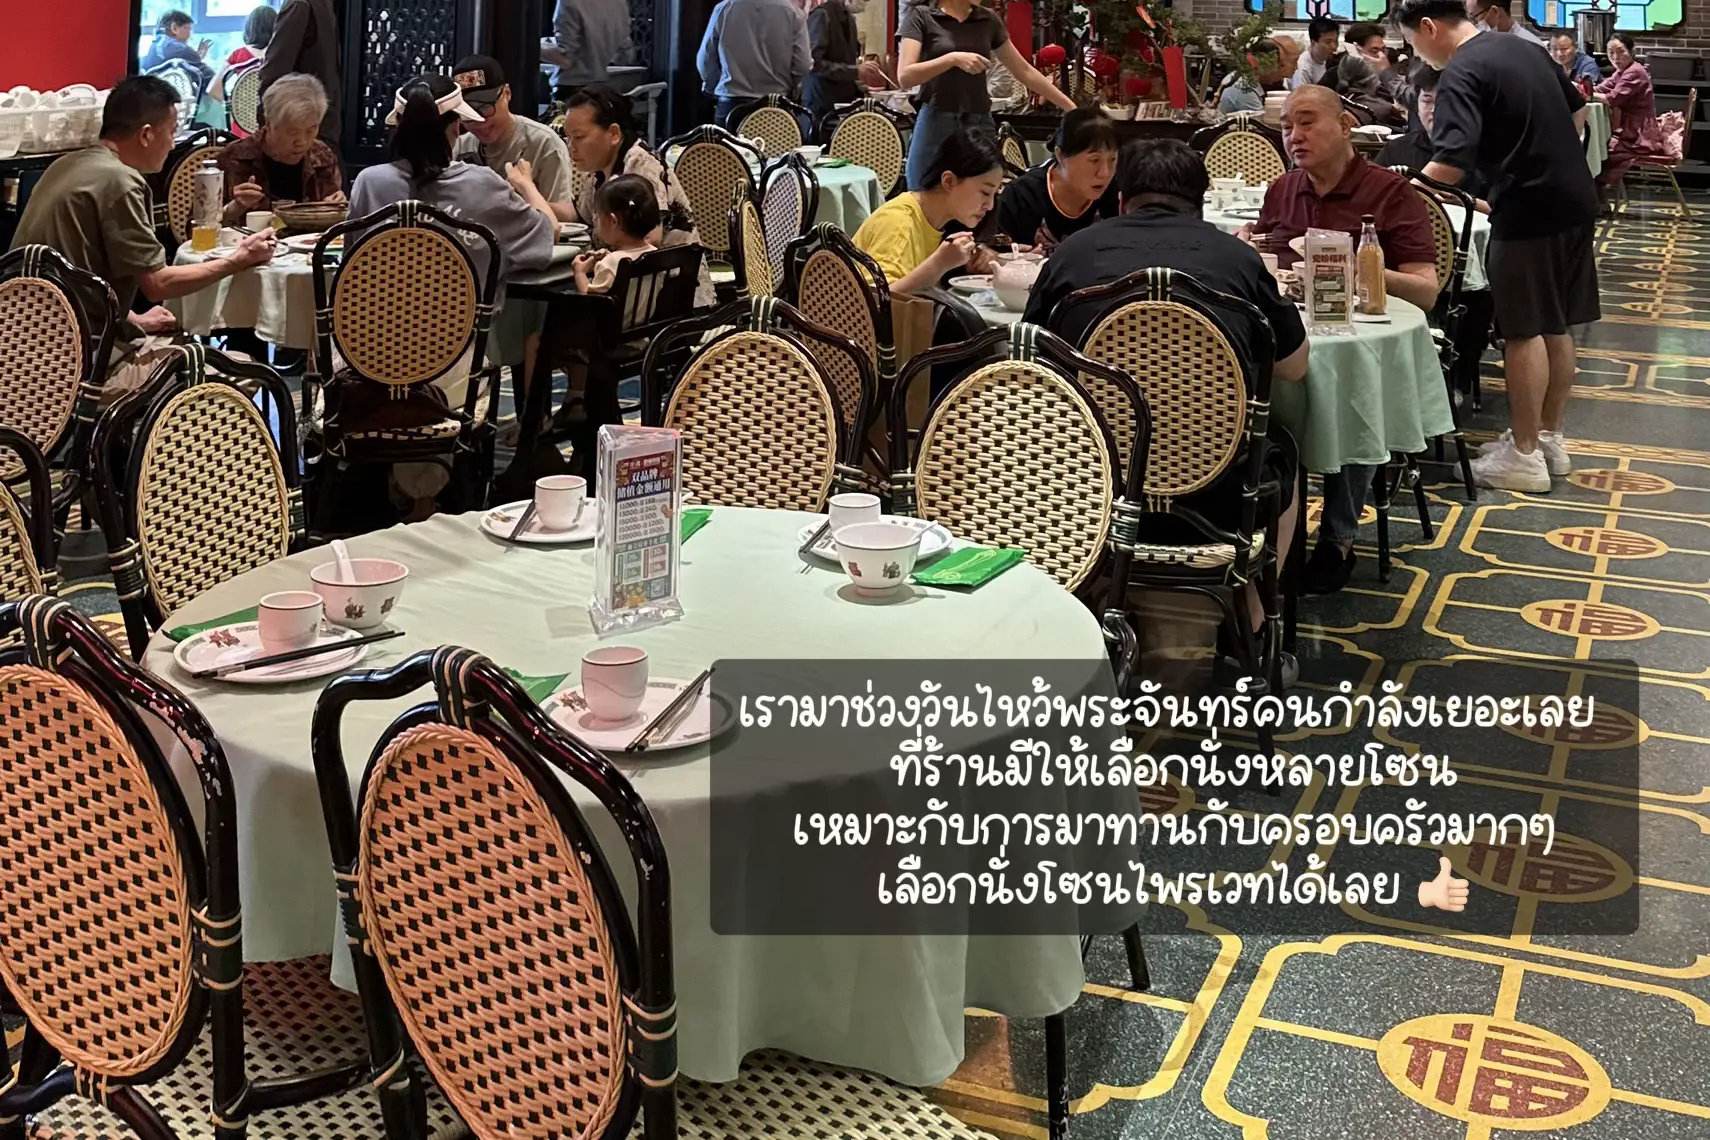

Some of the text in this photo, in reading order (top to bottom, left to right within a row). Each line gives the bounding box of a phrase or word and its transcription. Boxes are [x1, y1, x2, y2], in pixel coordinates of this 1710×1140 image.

[1559, 530, 1658, 556] 福
[1536, 603, 1648, 636] 福
[1402, 1023, 1590, 1118] 福
